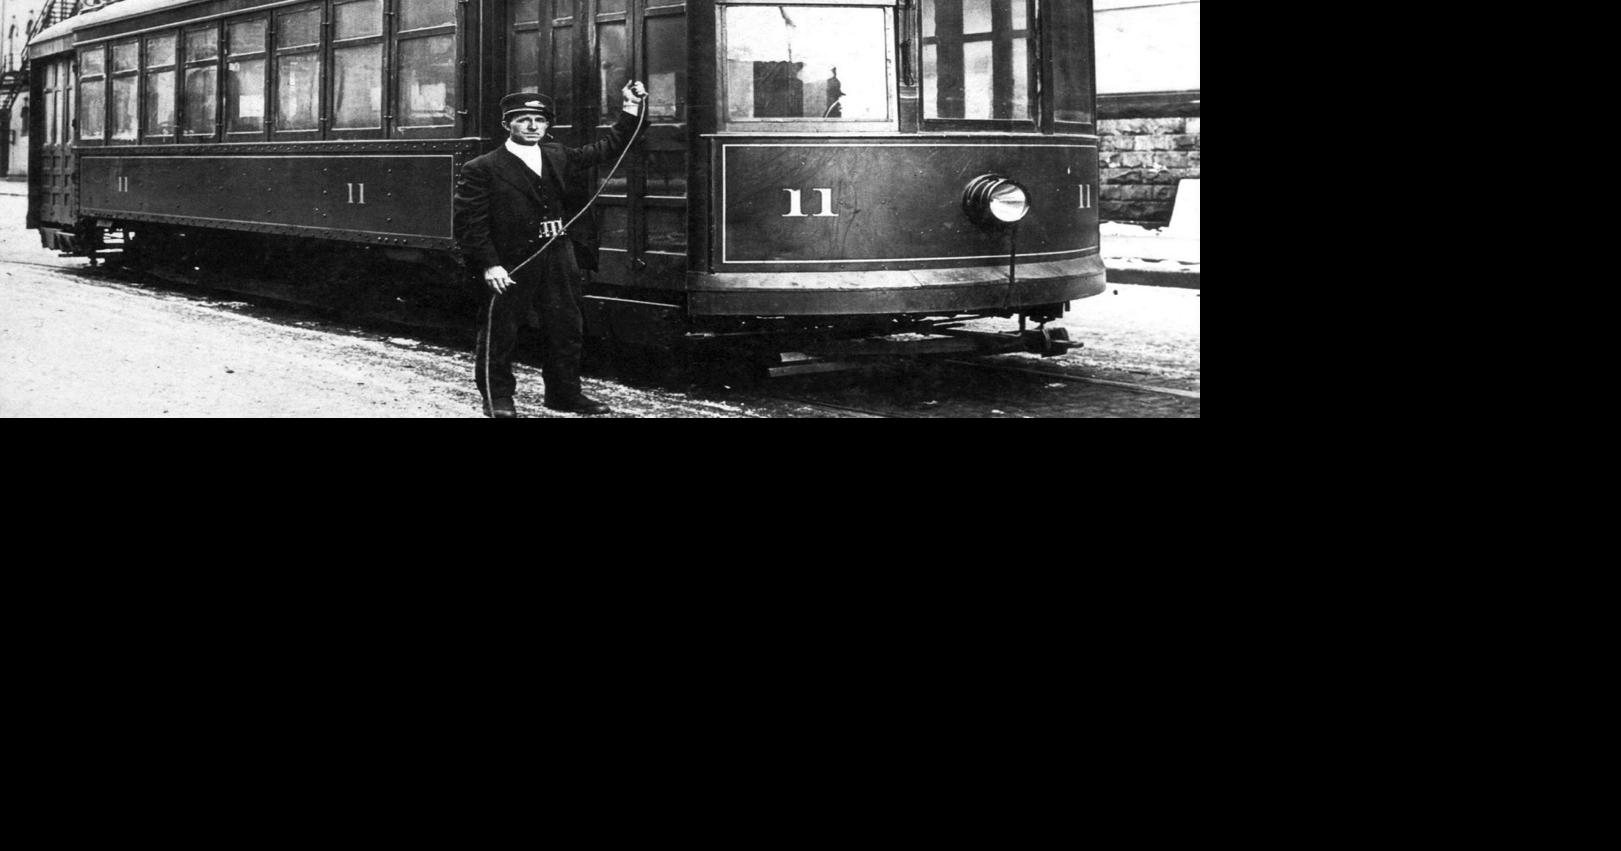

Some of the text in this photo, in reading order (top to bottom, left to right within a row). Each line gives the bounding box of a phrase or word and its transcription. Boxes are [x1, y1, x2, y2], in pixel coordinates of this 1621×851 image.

[118, 176, 128, 192] 11
[346, 182, 366, 204] 11
[781, 188, 839, 217] 11
[1078, 184, 1091, 208] 11
